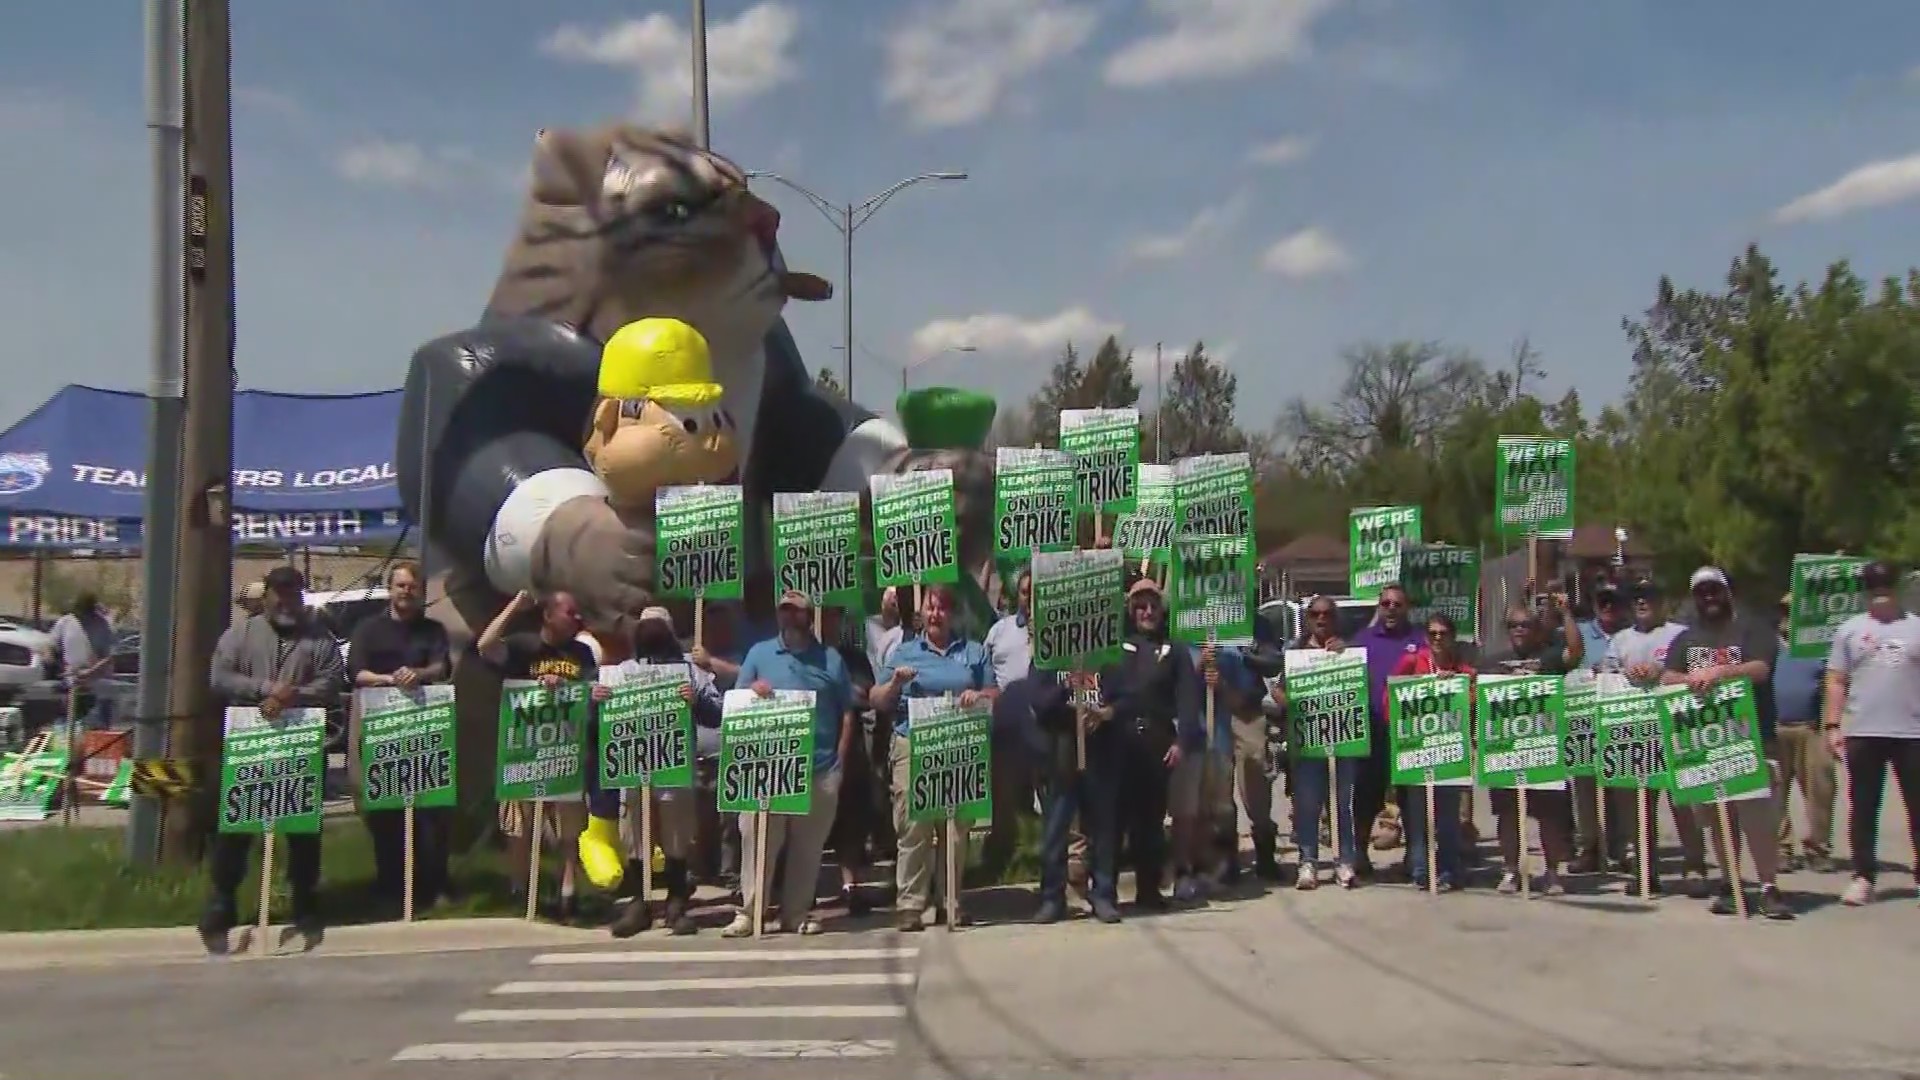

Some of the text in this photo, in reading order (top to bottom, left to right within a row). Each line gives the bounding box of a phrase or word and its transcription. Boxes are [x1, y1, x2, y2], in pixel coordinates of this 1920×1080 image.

[1062, 428, 1135, 447] TEAMSTERS
[1096, 451, 1128, 467] ULP
[1503, 441, 1567, 463] WE'RE
[293, 462, 398, 488] LOCAL
[1000, 471, 1073, 487] TEAMSTERS
[1076, 464, 1134, 506] TRIKE
[878, 489, 950, 516] TEAMSTERS
[1007, 493, 1065, 513] ON ULP
[1187, 497, 1242, 520] ON ULP
[661, 505, 739, 526] TEAMSTERS
[778, 512, 856, 534] TEAMSTERS
[1356, 508, 1416, 530] WE'RE
[9, 516, 119, 544] PRIDE
[660, 520, 738, 538] Brookfield Zoo
[886, 515, 944, 541] ON ULP
[1000, 508, 1073, 551] STRIKE
[1119, 519, 1175, 549] STRIK
[669, 530, 730, 553] ON ULP
[787, 538, 848, 560] ON ULP
[1178, 538, 1248, 561] WE'RE
[880, 529, 953, 580] STRIKE
[661, 546, 738, 591] STRIKE
[780, 553, 857, 597] STRIKE
[1802, 562, 1864, 580] WE'R
[1048, 599, 1111, 623] ON ULP
[1040, 613, 1119, 661] STRIKE
[509, 684, 583, 709] WERE
[605, 687, 679, 710] TEAMSTER
[1299, 691, 1357, 713] ON ULP
[1395, 679, 1465, 701] WE'RE
[1484, 680, 1559, 703] WE'RE
[1665, 681, 1746, 714] WERE
[514, 704, 575, 727] NOT
[1401, 693, 1455, 719] NOT
[1491, 696, 1550, 720] NOT
[1601, 698, 1655, 715] TEAMST
[365, 706, 450, 731] TEAMSTERS
[611, 712, 679, 738] ON ULP
[727, 711, 811, 731] TEAMSTERS
[1295, 706, 1366, 746] STRIKE
[1397, 710, 1462, 739] LION
[1485, 712, 1557, 741] LION
[1610, 720, 1663, 741] ON UL
[229, 731, 320, 752] TEAMSTERS
[507, 720, 580, 750] LION
[725, 727, 811, 744] Brookfield Zoo
[913, 719, 987, 743] TEAMSTERS
[1423, 732, 1464, 748] BEING
[1672, 718, 1750, 755] LION
[375, 733, 443, 759] ON ULP
[536, 744, 580, 759] BEING
[604, 728, 687, 779] STRIKE
[734, 739, 800, 760] ON ULP
[1514, 736, 1559, 751] BEING
[1707, 740, 1755, 762] BEING
[236, 758, 308, 781] ON ULP
[922, 745, 980, 771] ON ULP
[1602, 739, 1668, 779] STRIK
[367, 749, 452, 802] STRIKE
[724, 755, 809, 803] STRIKE
[914, 761, 988, 813] STRIKE
[226, 775, 317, 823] STRIKE
